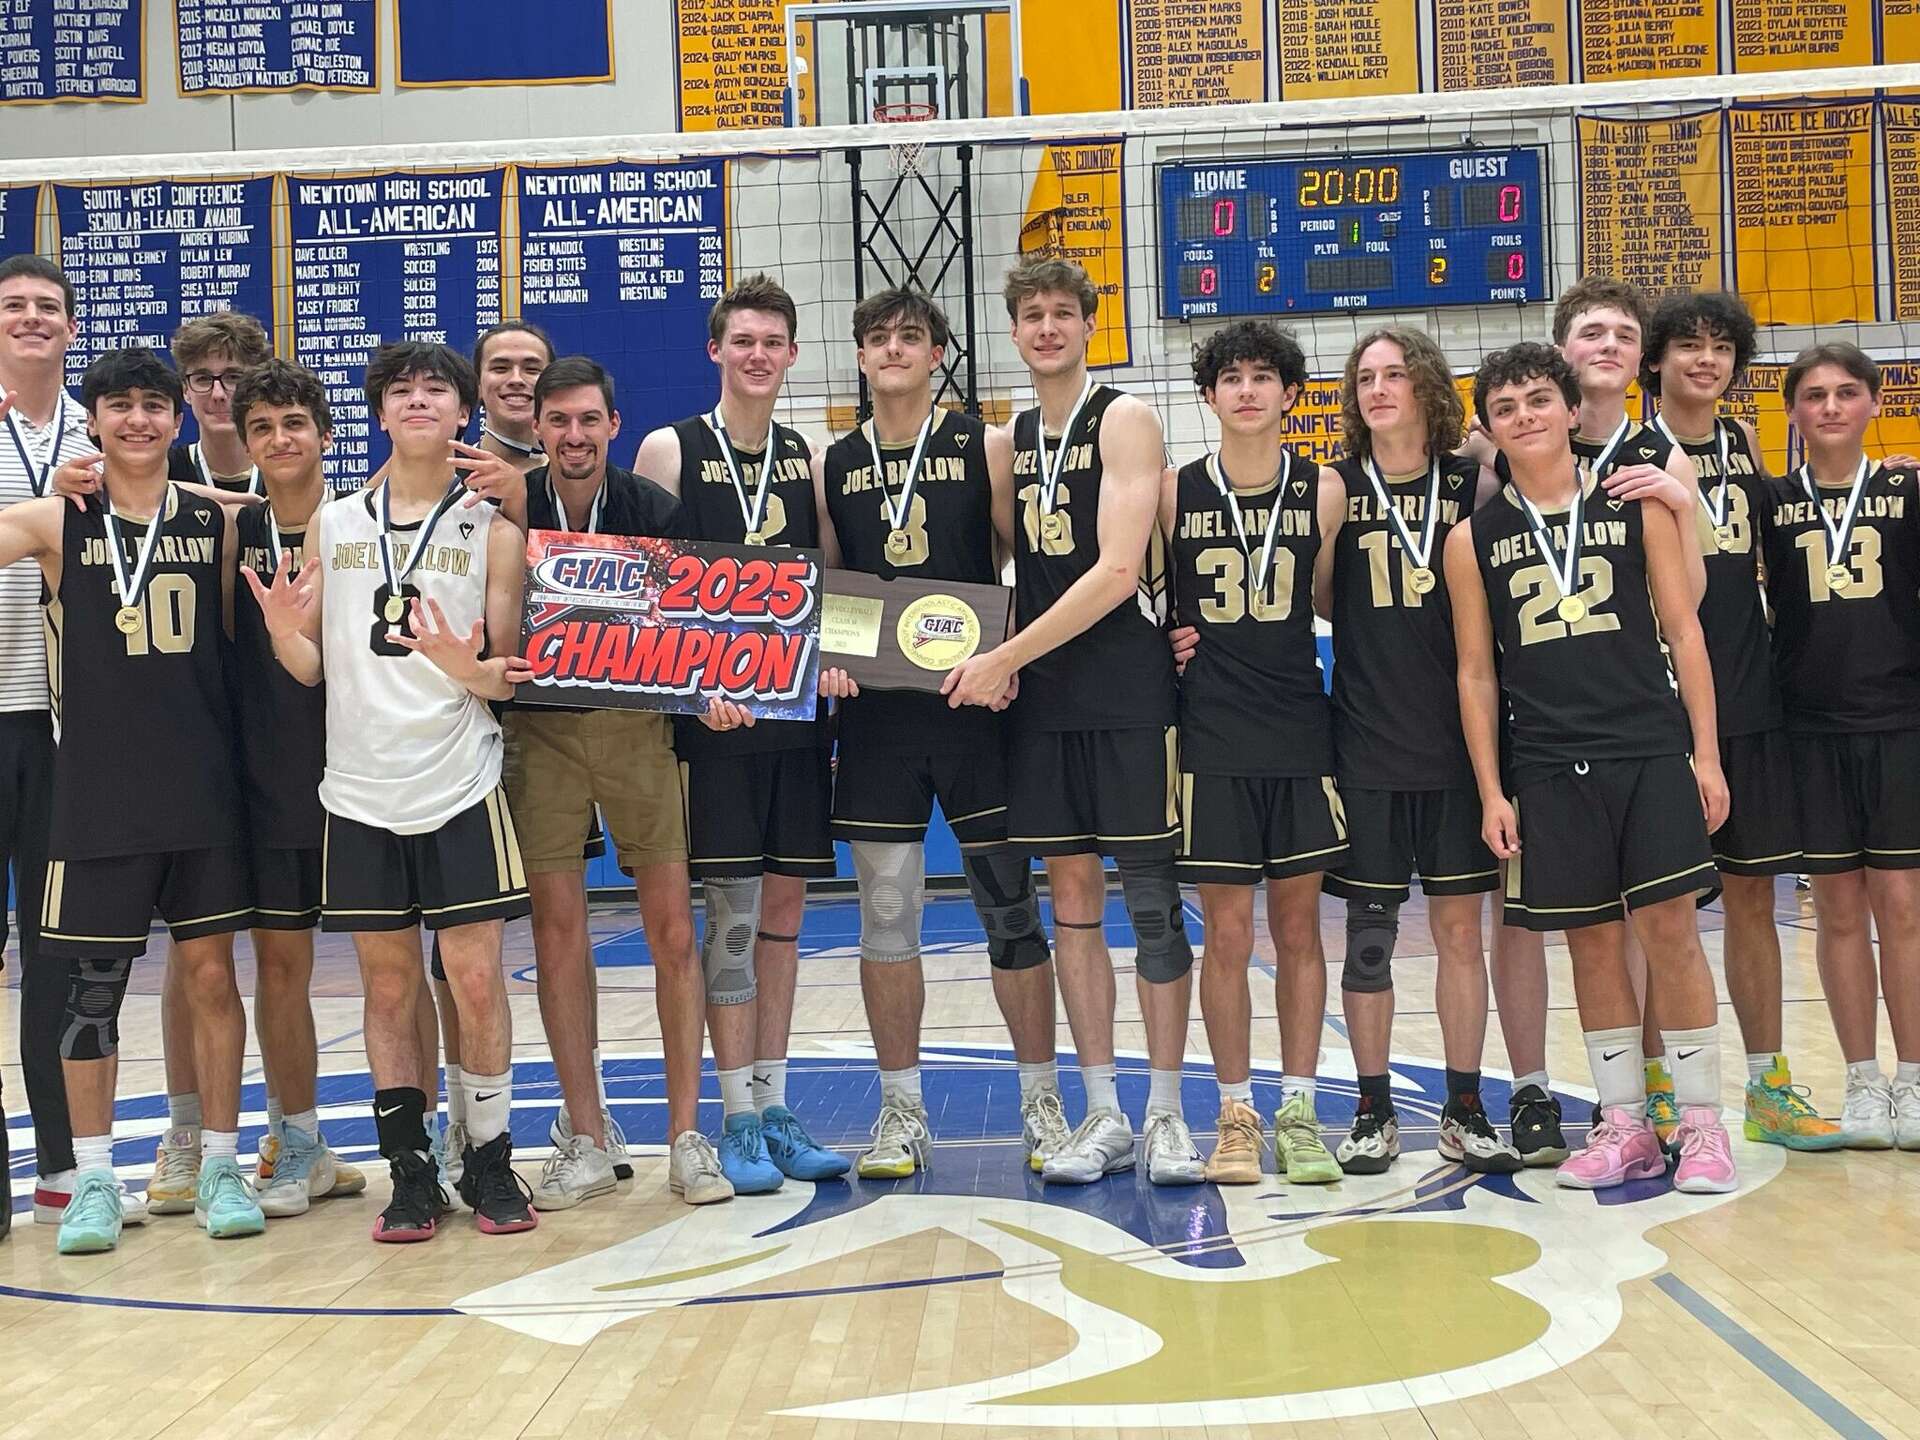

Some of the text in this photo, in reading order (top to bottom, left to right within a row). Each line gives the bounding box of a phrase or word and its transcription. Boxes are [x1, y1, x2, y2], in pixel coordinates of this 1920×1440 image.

[291, 5, 318, 18] JULIAN
[1210, 2, 1242, 13] MARKS
[1343, 7, 1373, 17] HOULE
[1796, 5, 1846, 16] PETERSEN
[1210, 15, 1242, 25] MARKS
[1350, 19, 1381, 29] HOULE
[291, 21, 355, 35] MICHAEL DOYLE
[1351, 31, 1381, 41] HOULE
[55, 47, 81, 60] SCOTT
[745, 51, 776, 60] MARKS
[1364, 56, 1387, 66] REED
[305, 68, 325, 83] TODD
[1357, 68, 1389, 79] LOKEY
[56, 79, 93, 93] STEPHEN
[1801, 111, 1818, 130] ICE
[1824, 107, 1869, 128] HOCKEY
[1652, 142, 1697, 154] FREEMAN
[1652, 155, 1697, 166] FREEMAN
[1450, 157, 1508, 179] GUEST
[525, 169, 717, 196] NEWTOWN HIGH SCHOOL
[1193, 170, 1247, 191] HOME
[1300, 168, 1397, 207] 20:00
[171, 184, 245, 205] CONFERENCE
[300, 178, 491, 205] NEWTOWN HIGH SCHOOL
[1498, 185, 1521, 222] 0
[204, 208, 241, 227] AWARD
[543, 195, 703, 227] ALL-AMERICAN
[1214, 199, 1235, 236] 0
[318, 203, 476, 235] ALL-AMERICAN
[1300, 219, 1335, 232] PERIOD
[1353, 222, 1359, 243] 1
[118, 236, 140, 248] GOLD
[180, 233, 213, 247] ANDREW
[619, 236, 722, 252] WRESTLING 2024
[1366, 242, 1390, 252] FOUL
[1491, 235, 1522, 246] FOULS
[404, 240, 498, 256] WRESTLING 1975
[524, 242, 546, 256] JAKE
[1257, 247, 1276, 258] TOL
[1314, 243, 1339, 255] PLYR
[180, 250, 209, 262] DYLAN
[619, 253, 722, 268] WRESTLING 2024
[1183, 250, 1214, 261] FOULS
[181, 266, 213, 280] ROBERT
[295, 262, 360, 279] MARCUS TRACY
[404, 258, 499, 274] SOCCER 2004
[1431, 257, 1447, 284] 2
[1508, 254, 1524, 280] 0
[1672, 263, 1702, 274] KELLY
[476, 276, 499, 290] 2005
[620, 271, 647, 285] TRACK
[660, 270, 684, 283] FIELD
[699, 270, 722, 283] 2024
[1200, 267, 1216, 295] 0
[1259, 266, 1275, 292] 2
[206, 282, 238, 296] TALBOT
[620, 286, 667, 301] WRESTLING
[700, 285, 723, 299] 2024
[1491, 288, 1526, 300] POINTS
[404, 294, 499, 309] SOCCER 2005
[524, 291, 546, 305] MARC
[1334, 295, 1367, 307] MATCH
[181, 300, 201, 313] RICK
[297, 300, 324, 315] CASEY
[1183, 302, 1218, 315] POINTS
[404, 313, 436, 327] SOCCER
[342, 459, 368, 473] FALBO
[1773, 502, 1817, 527] JOEL
[1180, 511, 1226, 538] JOEL
[332, 542, 379, 570] JOEL
[1490, 532, 1536, 568] JOEL
[1795, 526, 1884, 602] 13
[552, 557, 647, 592] CIAC
[659, 555, 818, 627] 2025
[1196, 547, 1295, 623] 30
[1509, 555, 1621, 646] 22
[526, 621, 812, 701] CHAMPION
